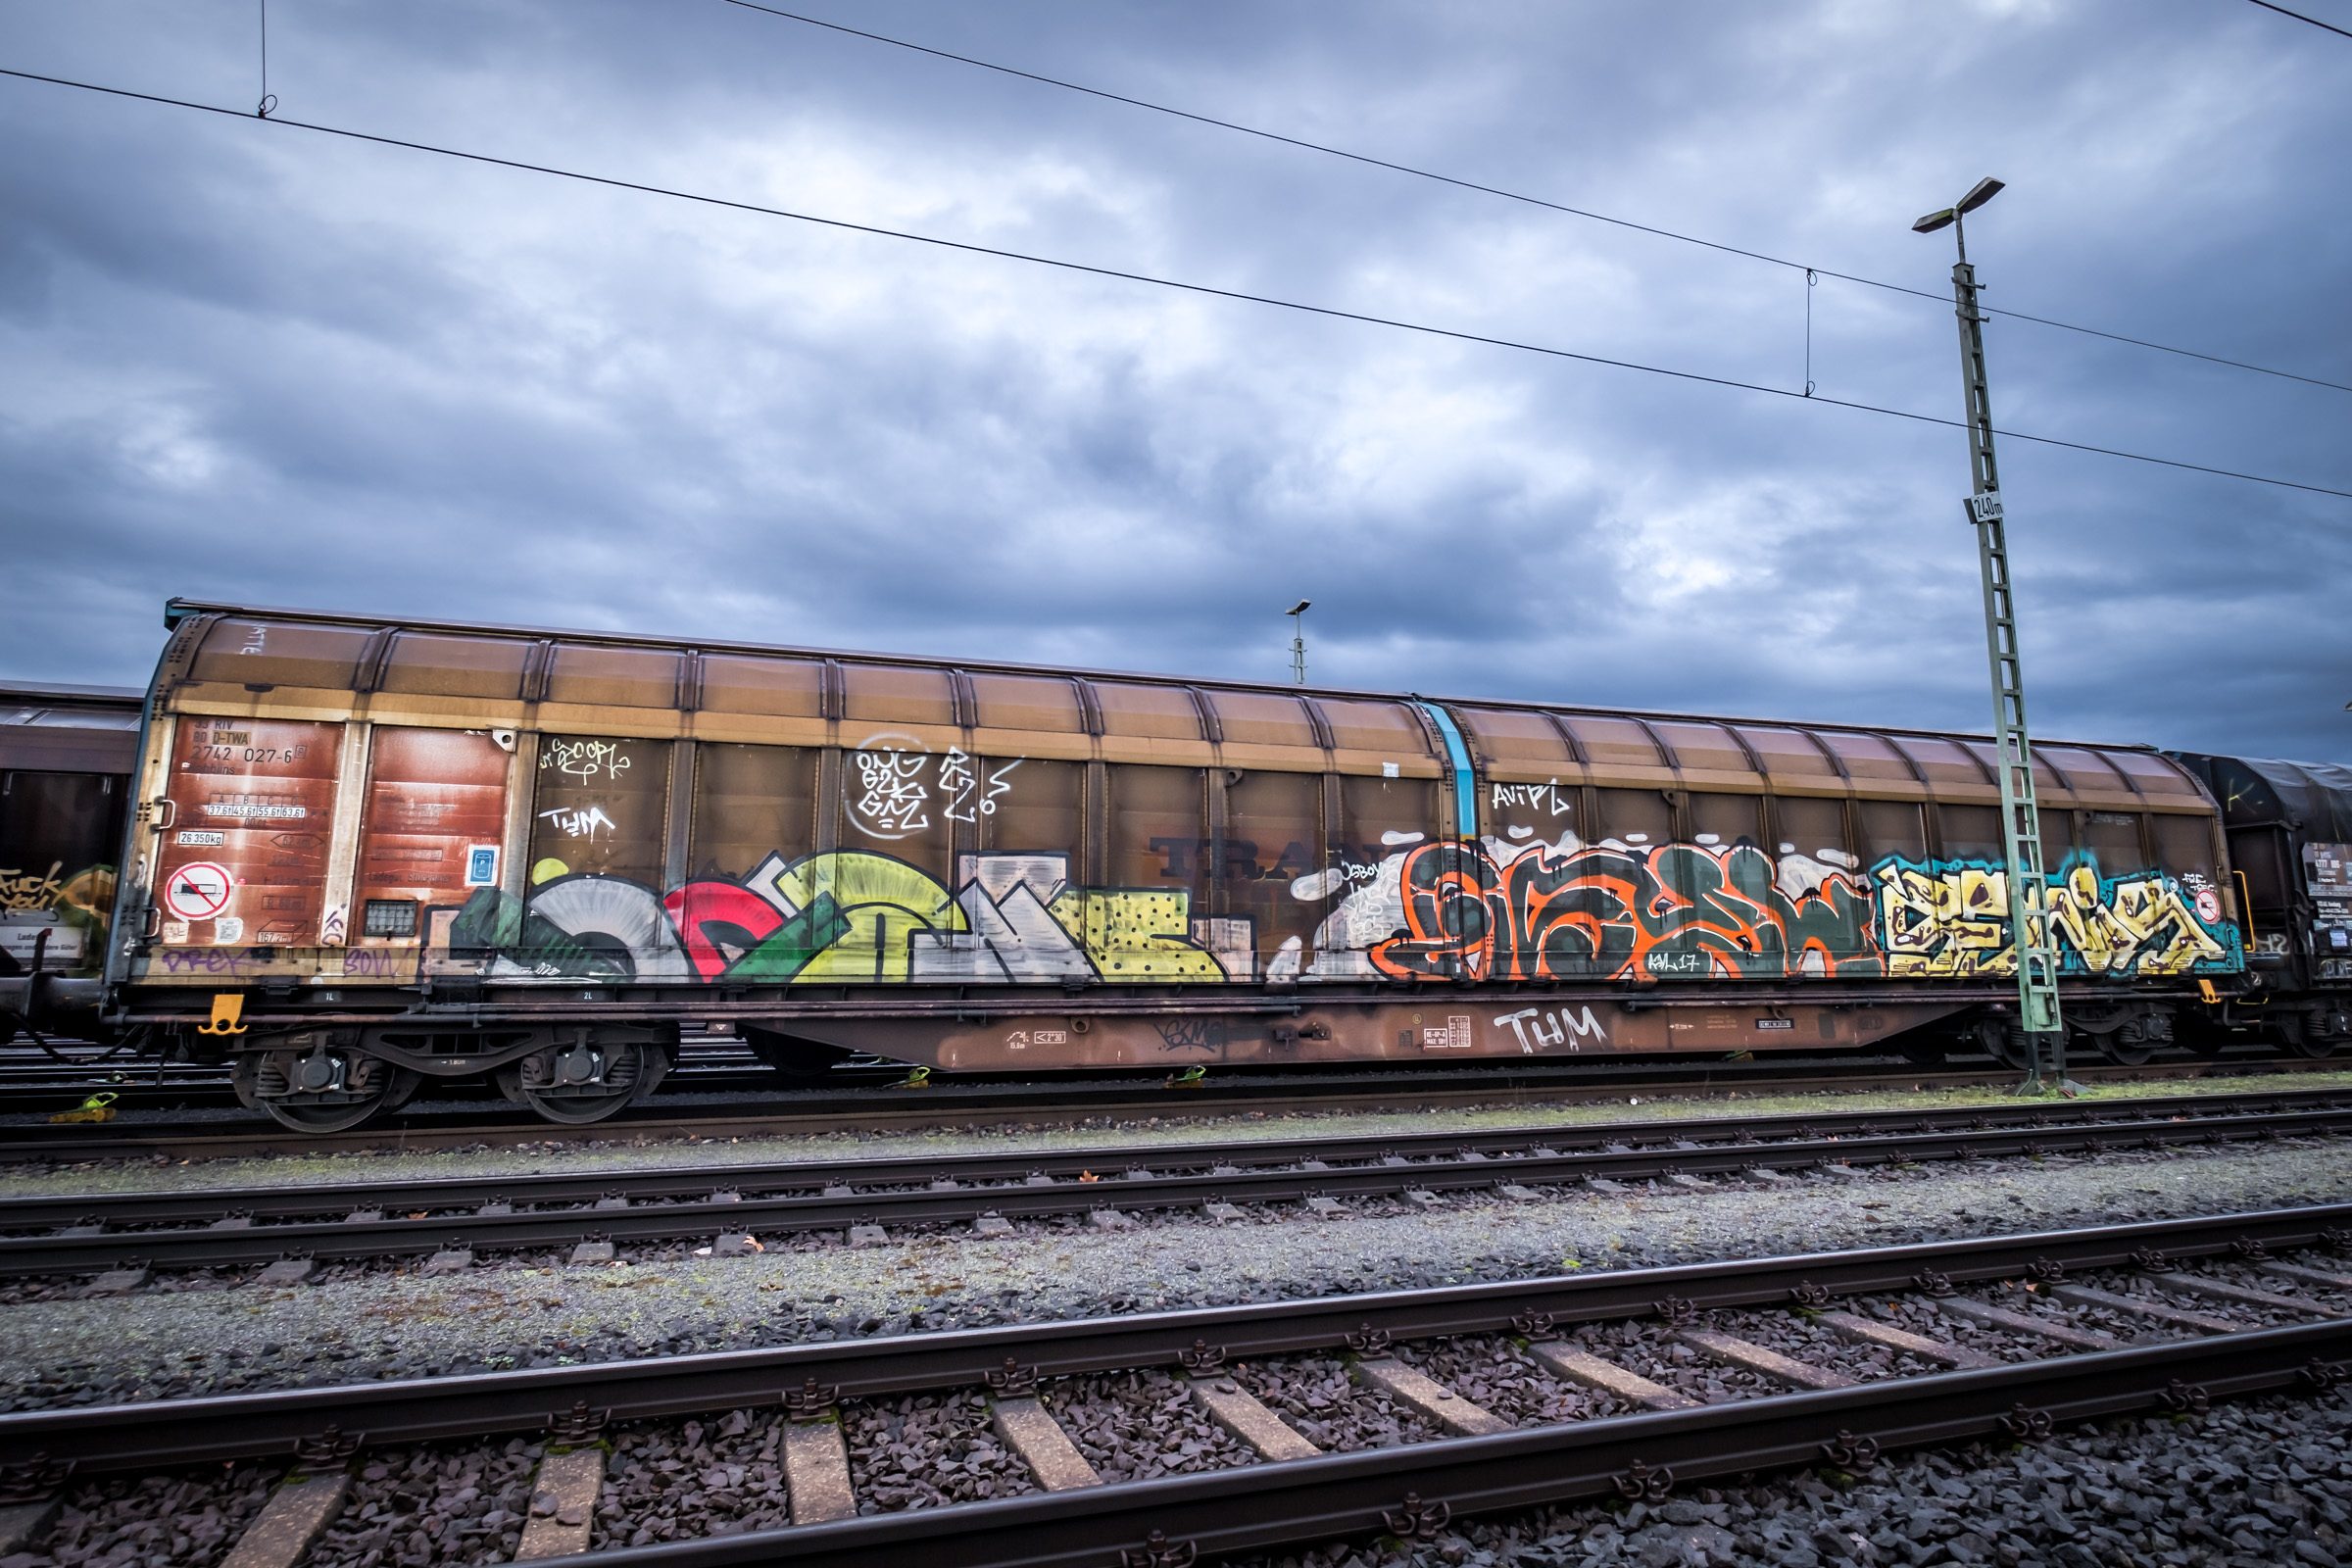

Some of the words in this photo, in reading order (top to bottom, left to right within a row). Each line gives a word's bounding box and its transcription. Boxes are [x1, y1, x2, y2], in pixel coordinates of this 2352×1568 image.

[1974, 496, 2004, 518] 240m
[215, 720, 234, 730] RIV
[213, 732, 249, 745] D-TWA
[191, 746, 232, 760] 2742
[244, 748, 292, 763] 027-6
[583, 991, 593, 1000] 2L
[1494, 1005, 1608, 1054] TUM
